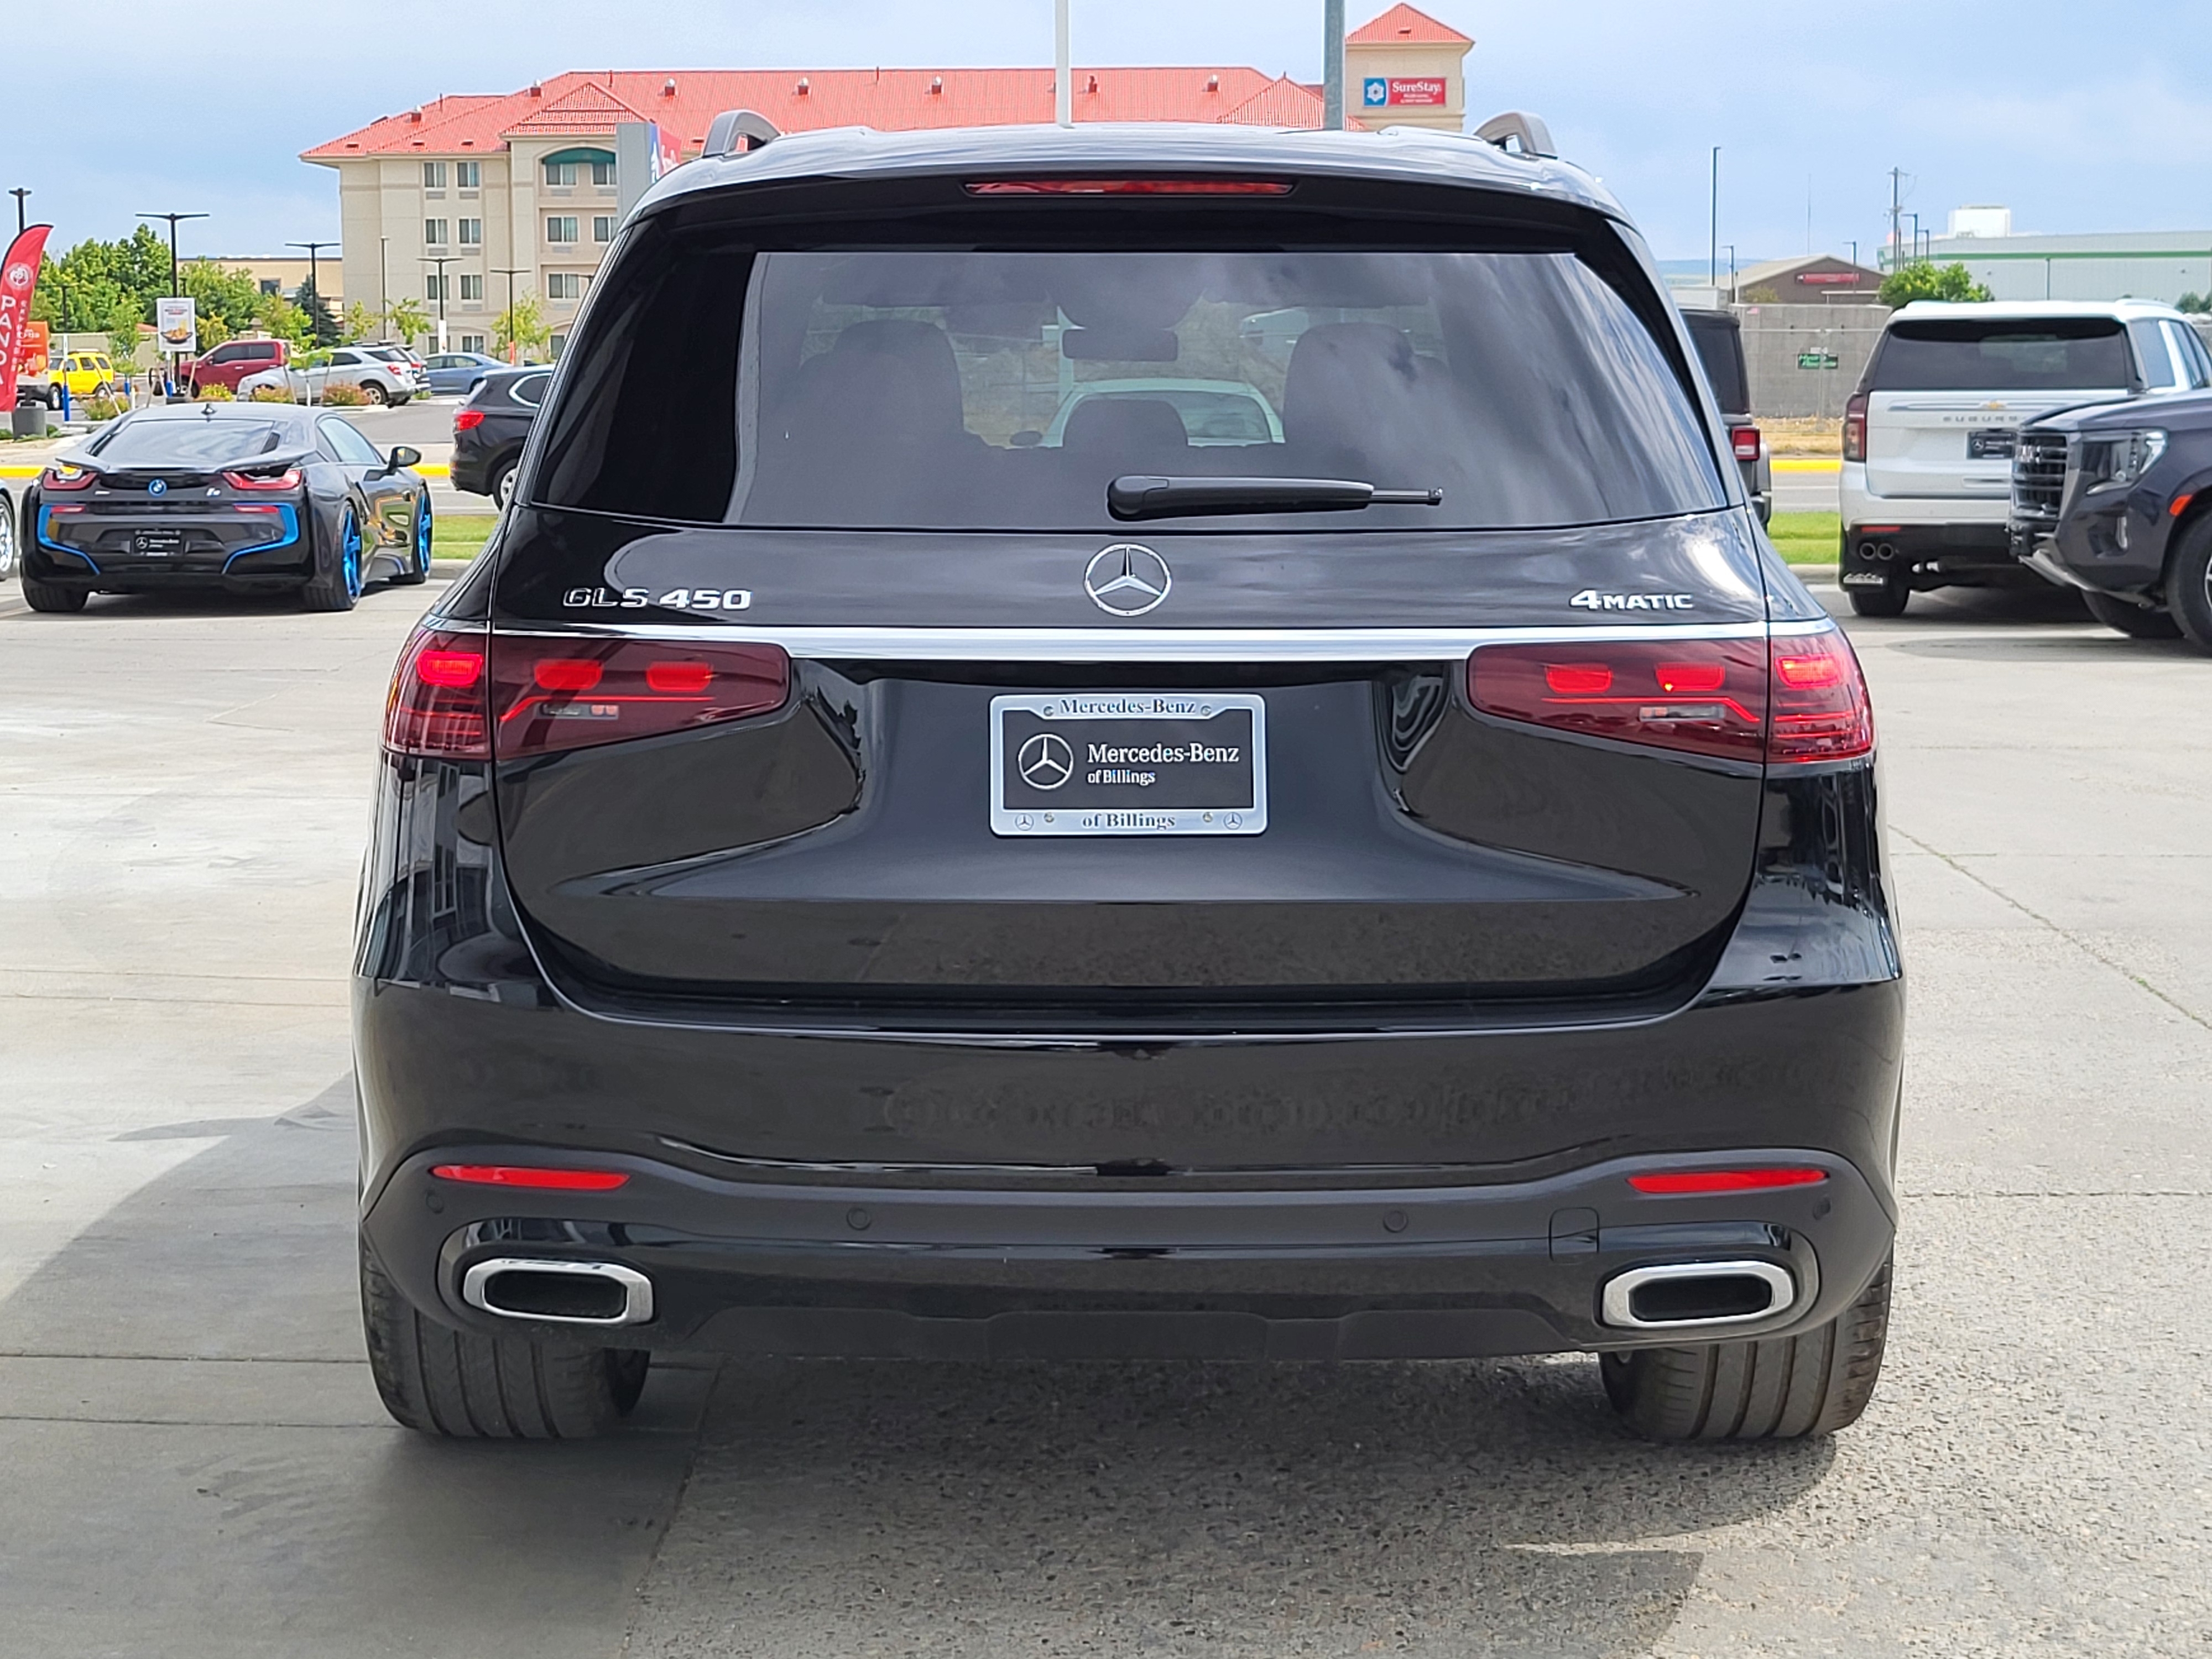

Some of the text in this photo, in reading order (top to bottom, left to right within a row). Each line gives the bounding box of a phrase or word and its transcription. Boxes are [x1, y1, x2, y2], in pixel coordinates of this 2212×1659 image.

[1392, 81, 1440, 95] SureStay
[0, 295, 16, 384] PAND
[563, 587, 753, 610] GLS 450
[1570, 589, 1694, 609] 4MATIC
[1060, 699, 1196, 714] Mercedes-Benz
[1087, 742, 1239, 763] Mercedes-Benz
[1087, 769, 1156, 786] of Billings
[1082, 812, 1176, 830] of Billings
